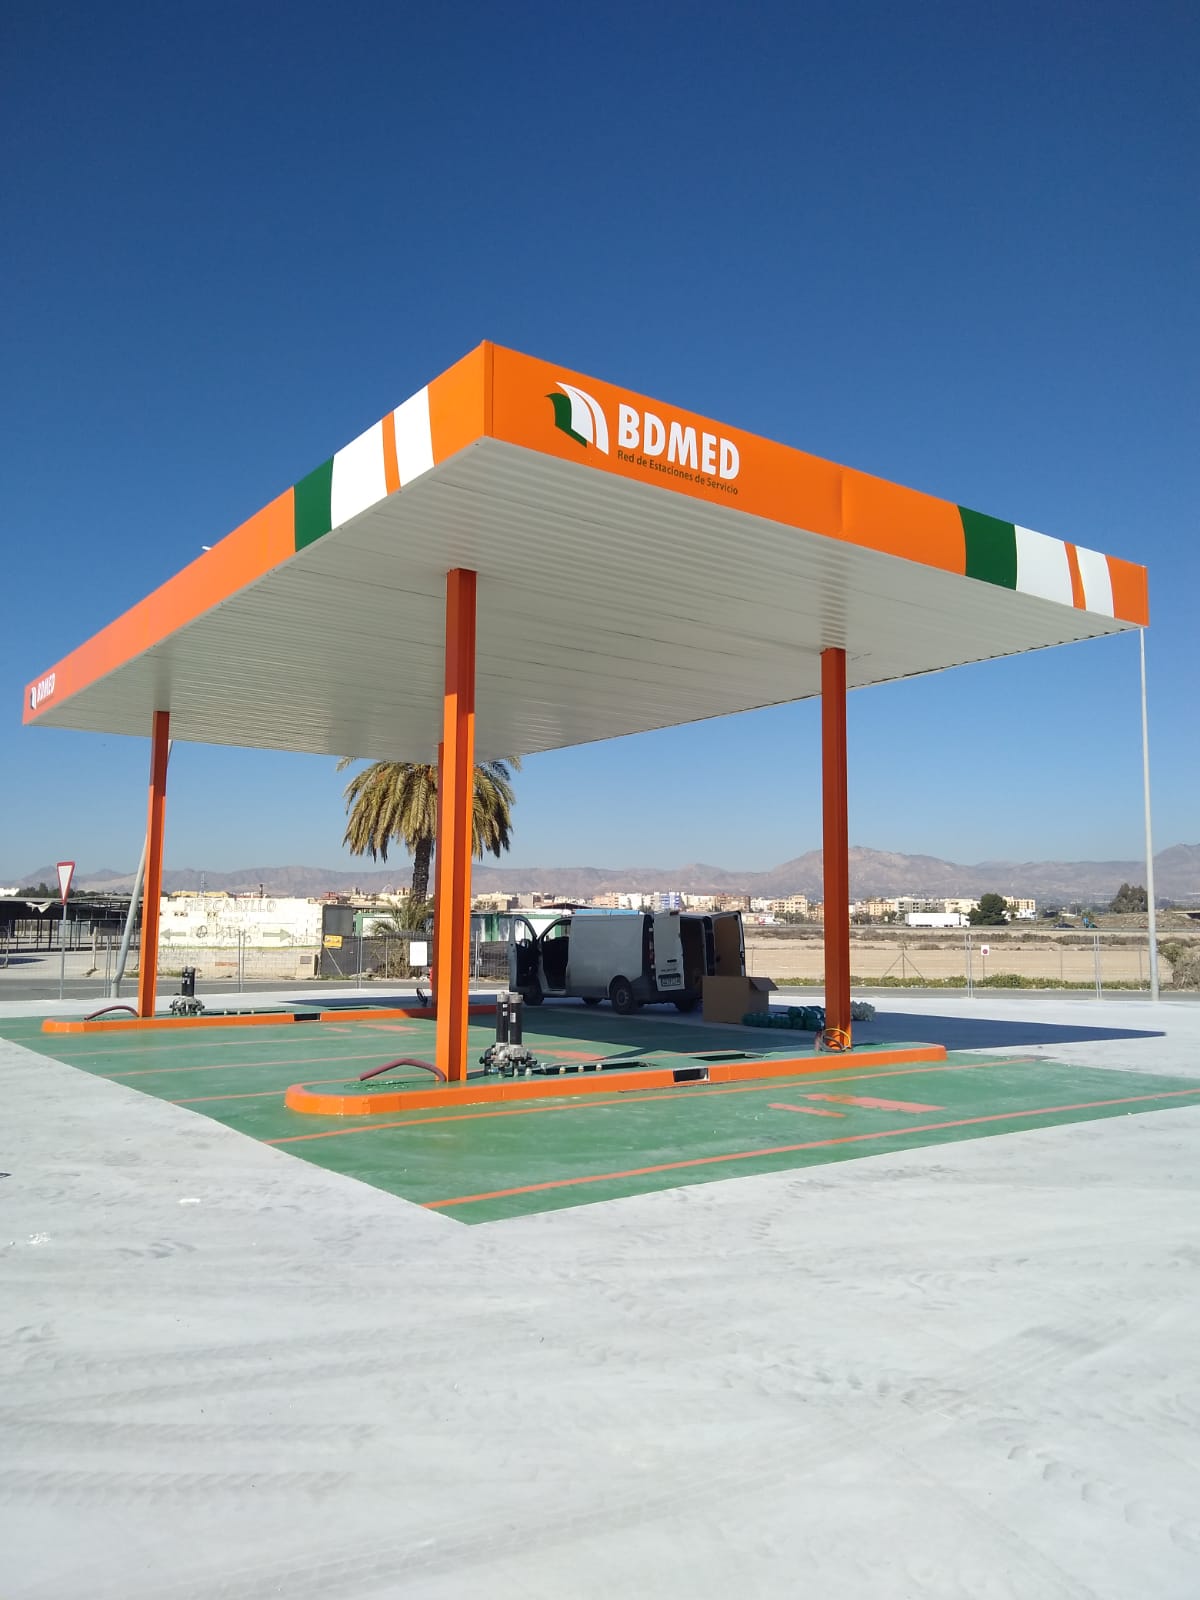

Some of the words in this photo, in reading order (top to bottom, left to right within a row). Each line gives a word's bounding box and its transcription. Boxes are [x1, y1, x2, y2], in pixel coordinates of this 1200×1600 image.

[618, 403, 740, 480] BDMED
[617, 449, 634, 463] Red
[636, 455, 647, 467] de
[649, 459, 693, 482] Estaciones
[695, 474, 705, 485] de
[706, 477, 738, 495] Servicio
[184, 899, 277, 912] MERCADILLO
